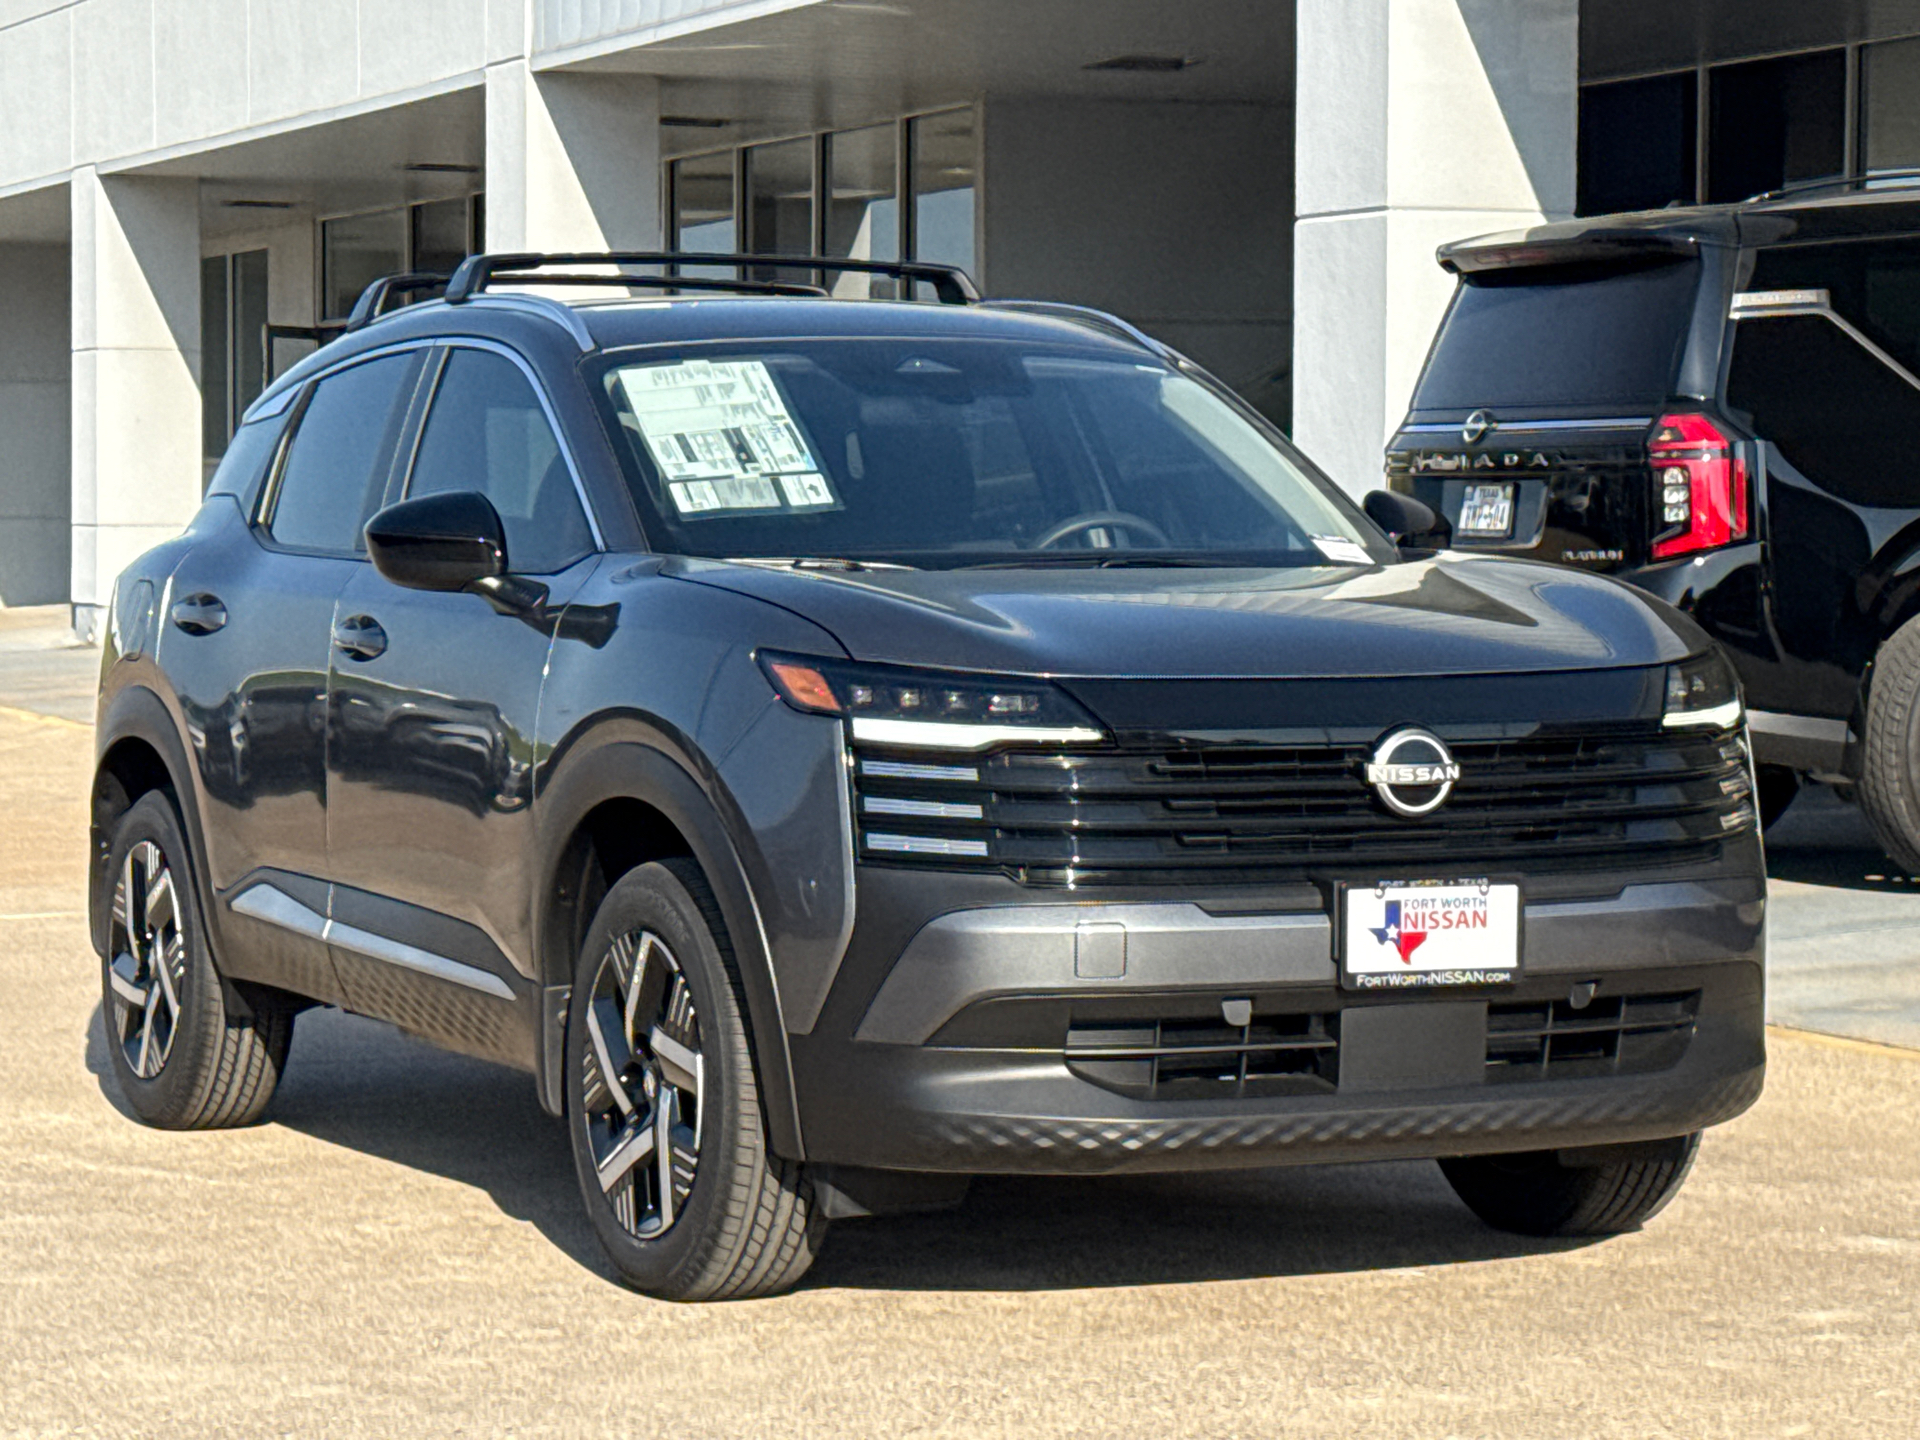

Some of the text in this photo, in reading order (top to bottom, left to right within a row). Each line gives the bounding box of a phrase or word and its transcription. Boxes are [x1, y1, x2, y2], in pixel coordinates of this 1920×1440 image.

[1369, 765, 1460, 782] NISSAN
[1458, 878, 1489, 886] TEXAS
[1404, 897, 1488, 910] FORT WORTH
[1404, 909, 1488, 930] NISSAN
